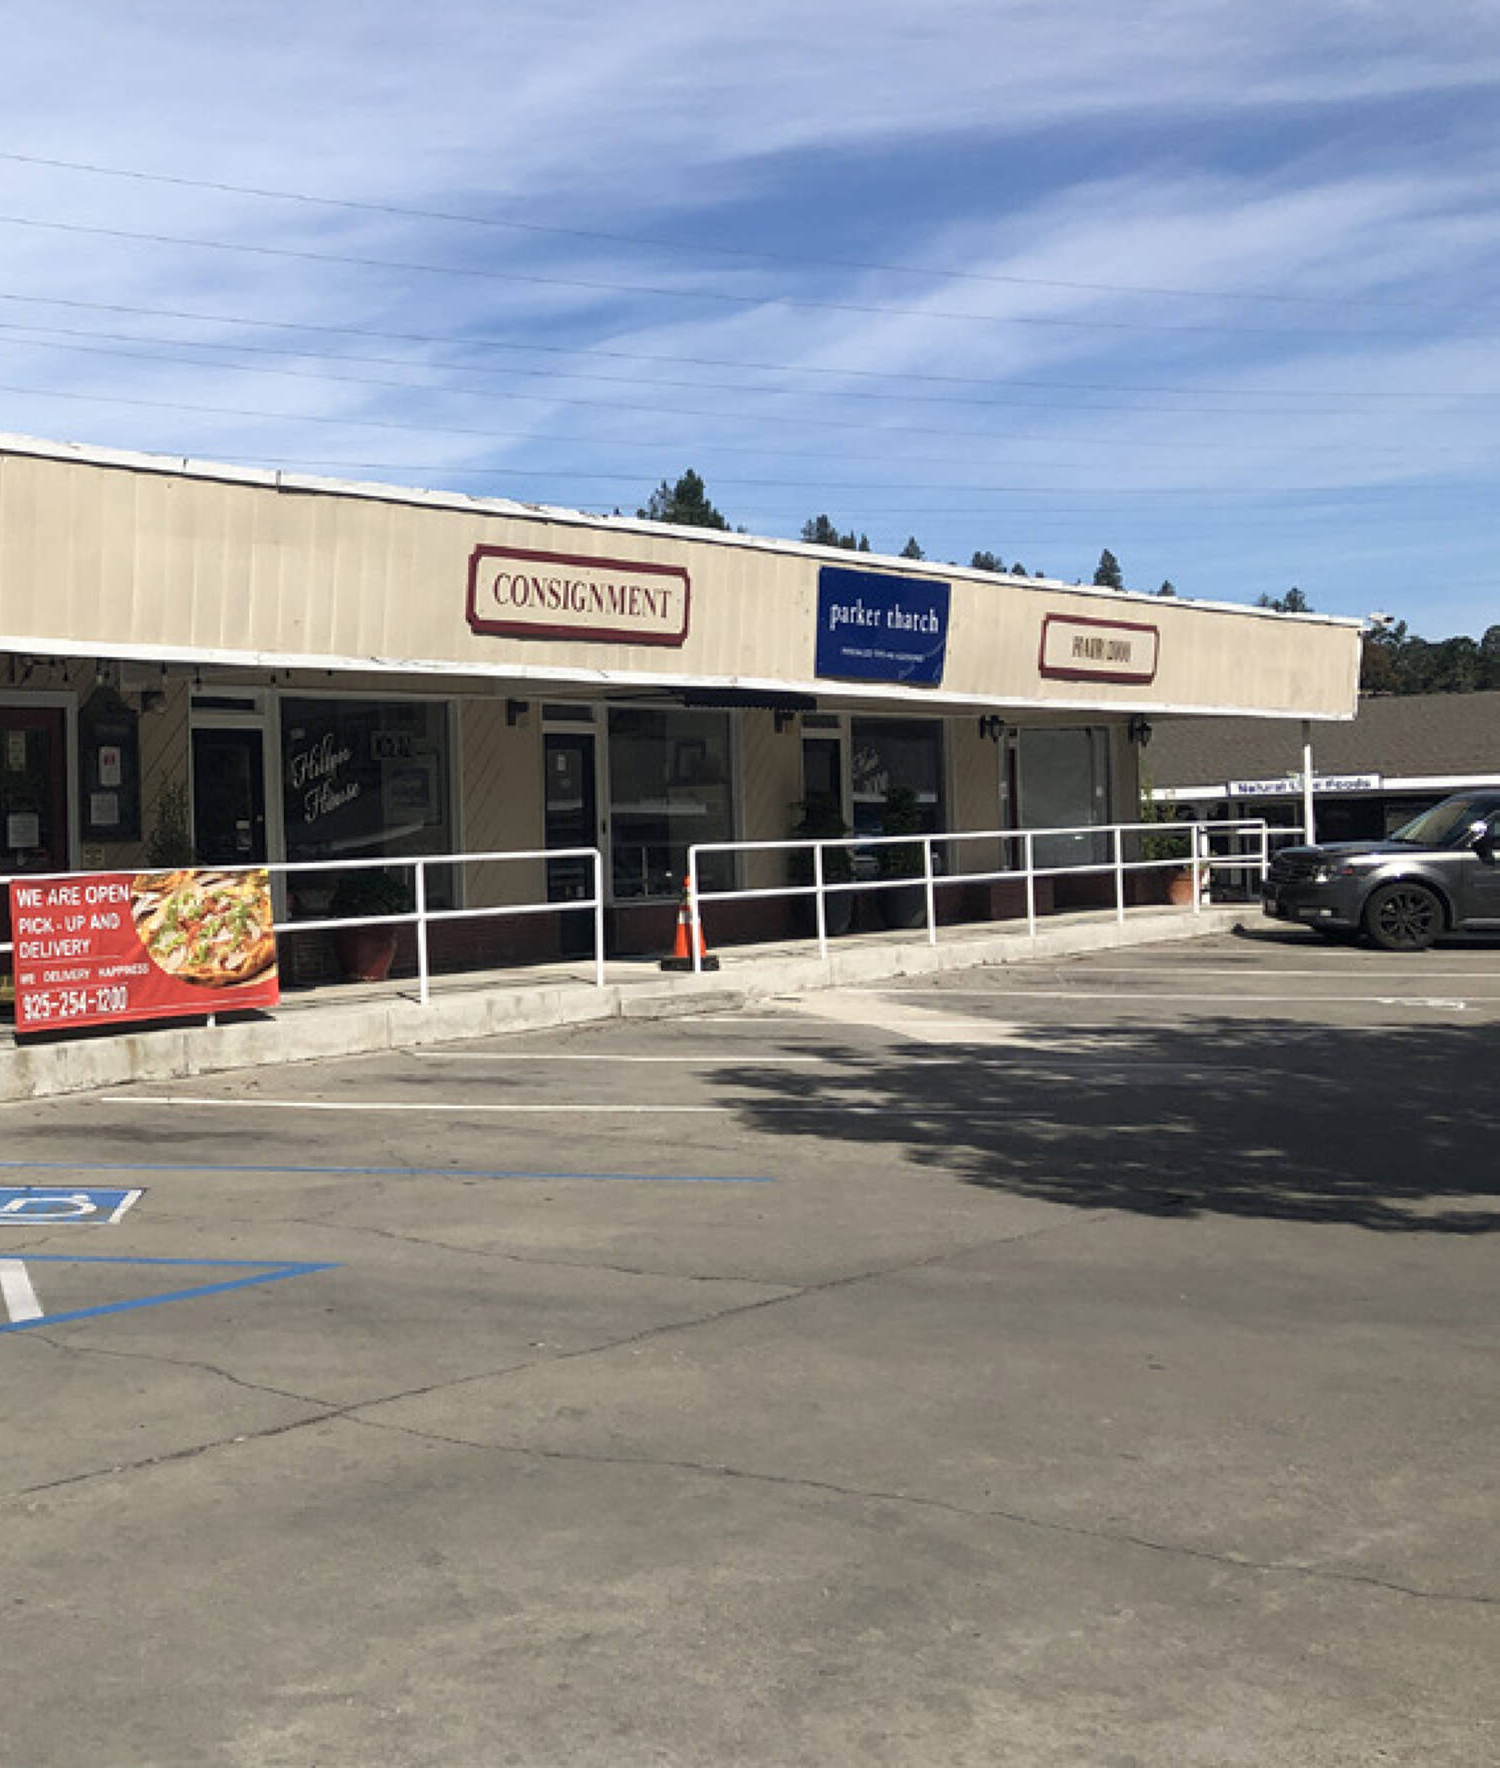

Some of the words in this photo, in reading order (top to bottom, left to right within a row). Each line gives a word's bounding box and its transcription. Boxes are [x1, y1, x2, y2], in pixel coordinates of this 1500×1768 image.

[493, 572, 672, 618] CONSIGNMENT
[829, 598, 881, 632] parker
[16, 889, 43, 907] WE
[47, 886, 82, 906] ARE
[85, 884, 130, 905] OPEN
[90, 913, 121, 930] AND
[19, 939, 91, 959] DELIVERY
[22, 986, 128, 1021] 925-254-1200
